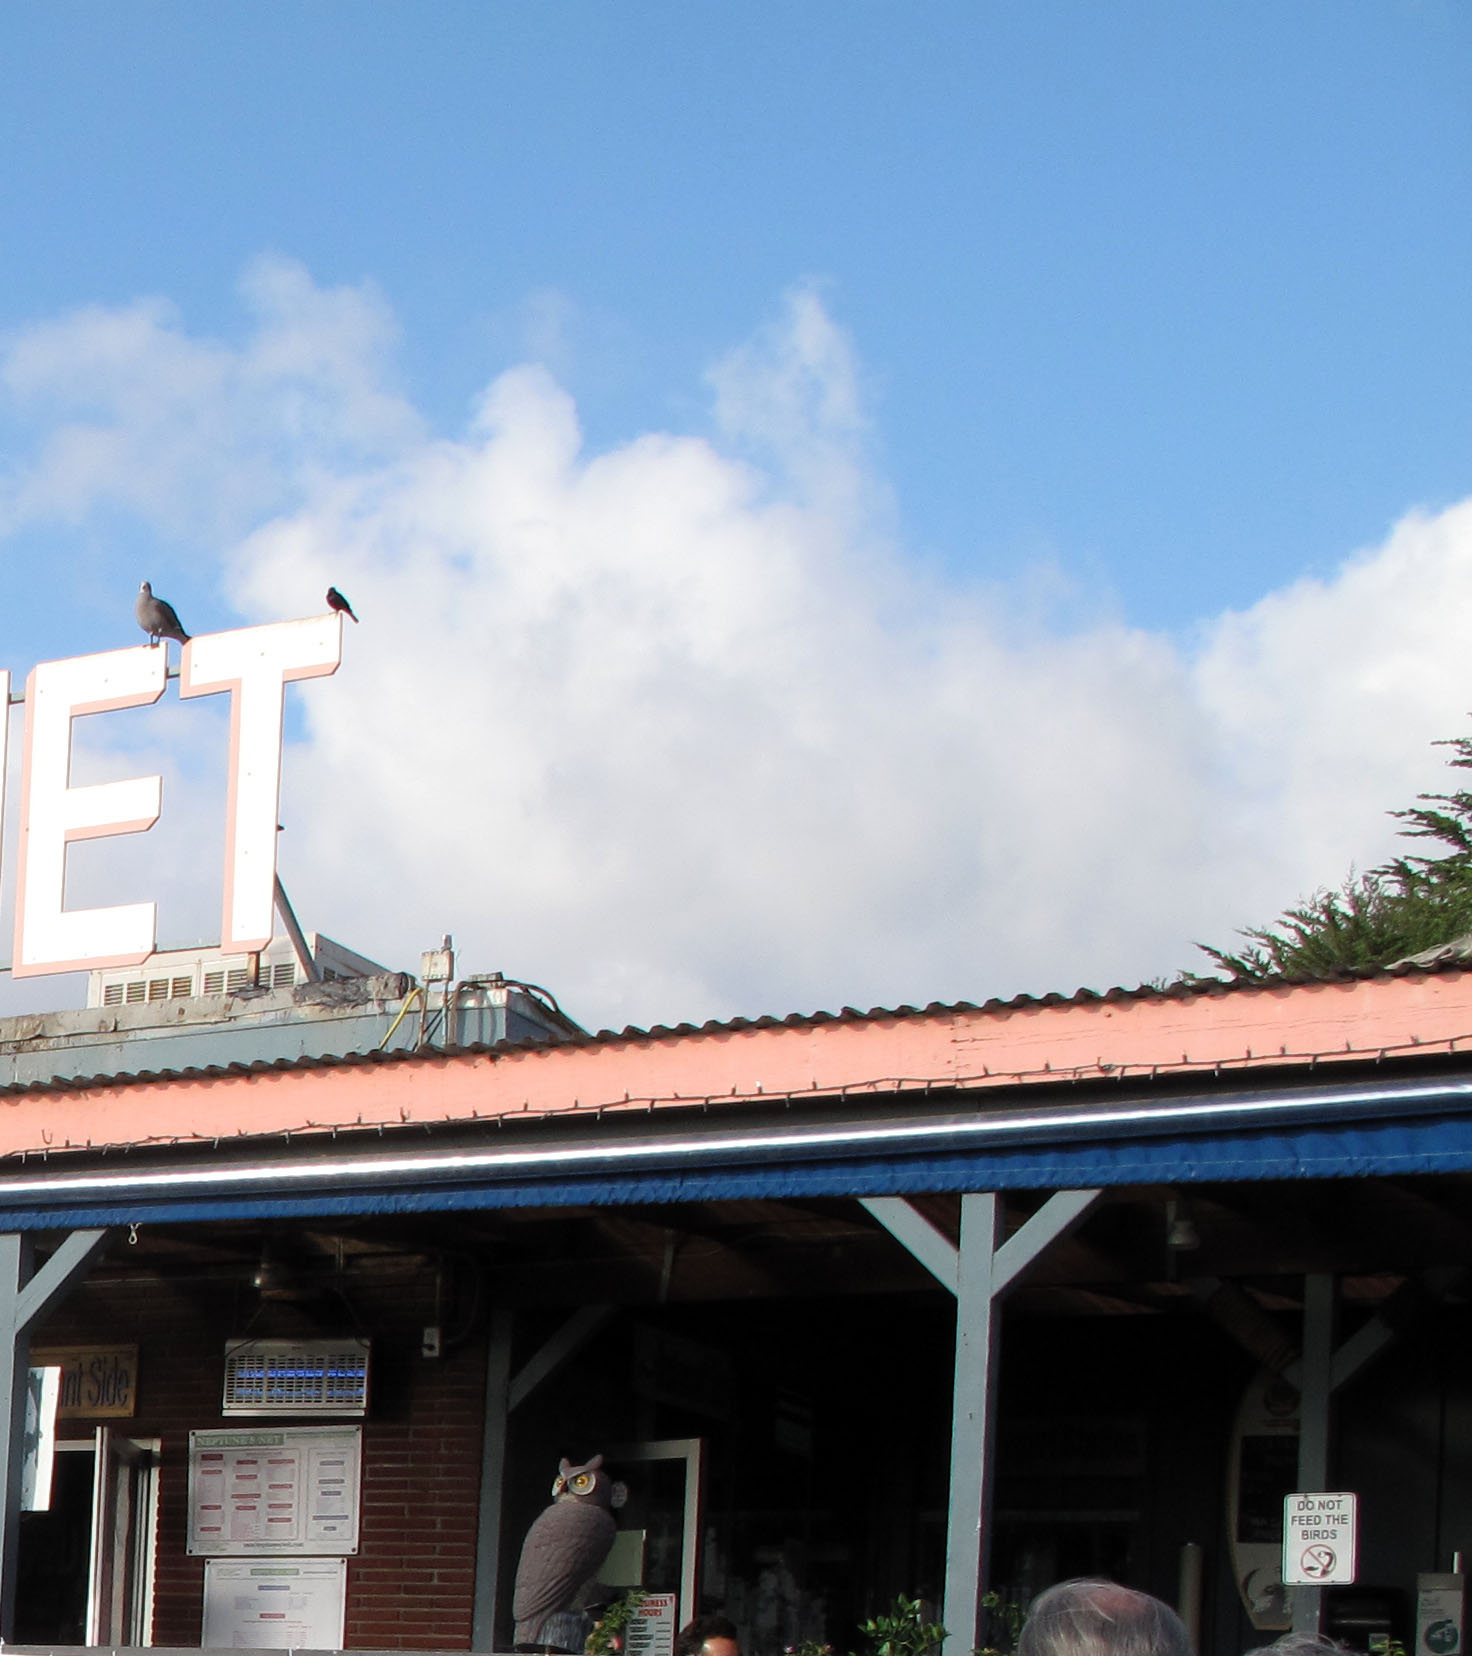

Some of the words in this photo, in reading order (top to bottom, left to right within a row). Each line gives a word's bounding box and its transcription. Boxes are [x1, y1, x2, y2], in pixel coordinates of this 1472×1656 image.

[87, 1354, 130, 1407] Side
[1297, 1500, 1314, 1511] DO
[1317, 1499, 1343, 1510] NOT
[1291, 1515, 1322, 1526] FEED
[1325, 1514, 1349, 1525] THE
[1301, 1529, 1338, 1540] BIRDS
